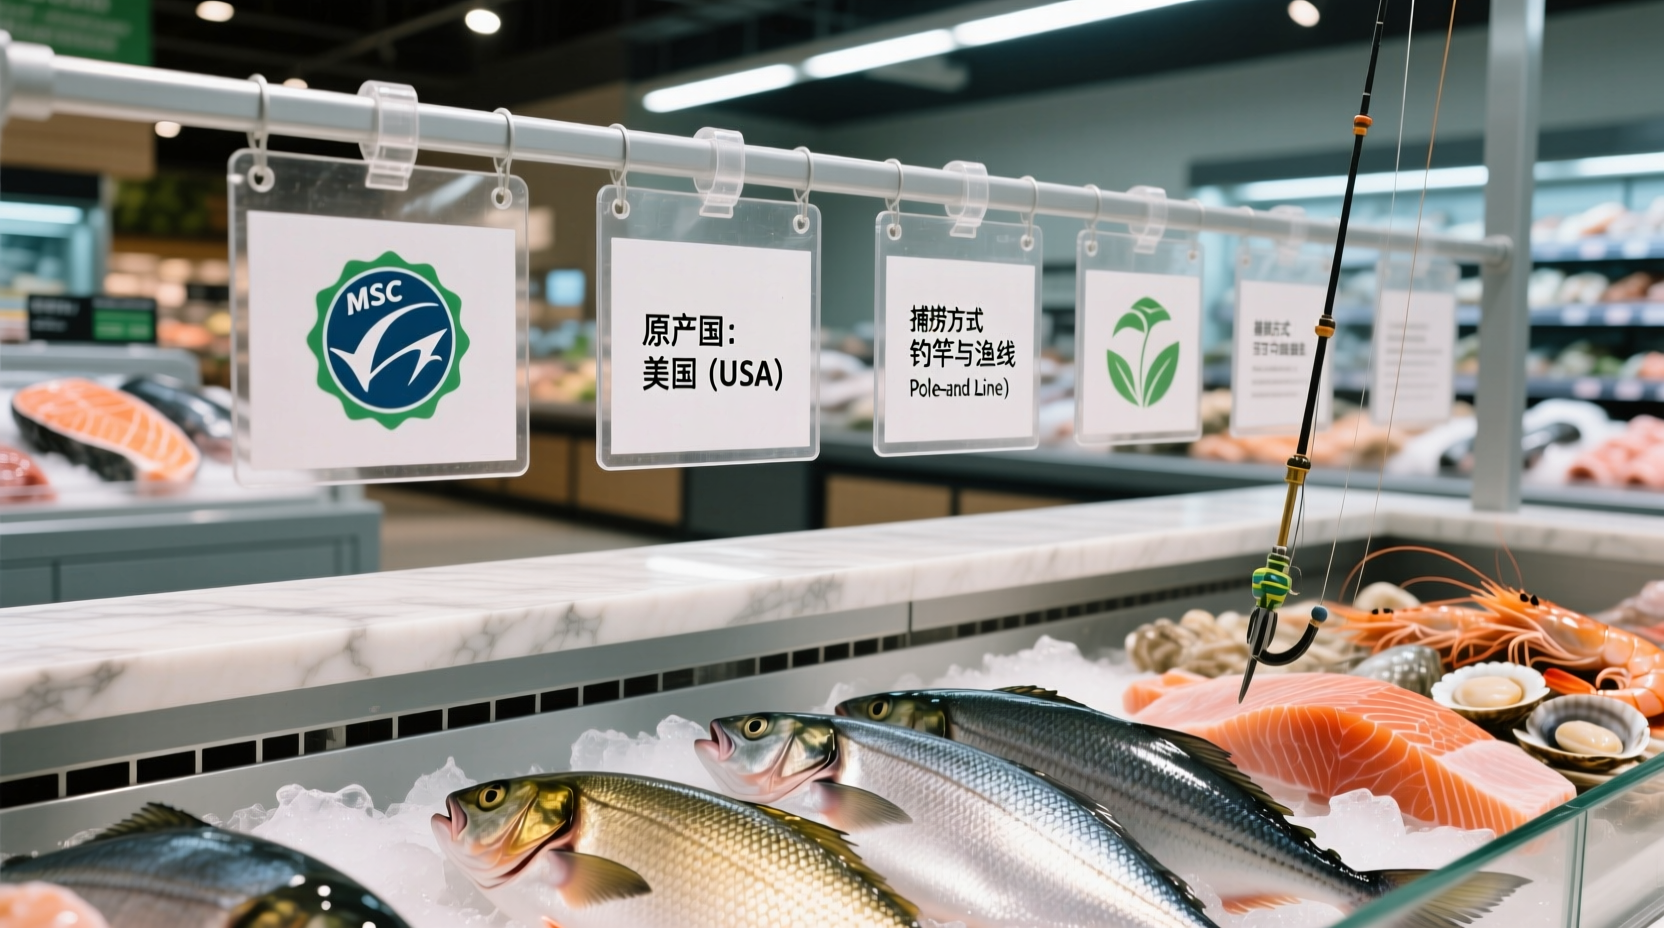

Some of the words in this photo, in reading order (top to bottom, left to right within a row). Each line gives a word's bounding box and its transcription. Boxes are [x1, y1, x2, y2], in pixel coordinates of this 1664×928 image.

[347, 279, 403, 316] MSC
[642, 312, 735, 347] 原产国：
[909, 304, 984, 333] 捕捞方式
[910, 337, 1016, 368] 钓竿与渔线
[643, 355, 696, 391] 美国
[709, 357, 783, 392] (USA)
[910, 377, 970, 398] Pole-and
[974, 377, 1009, 400] Line)
